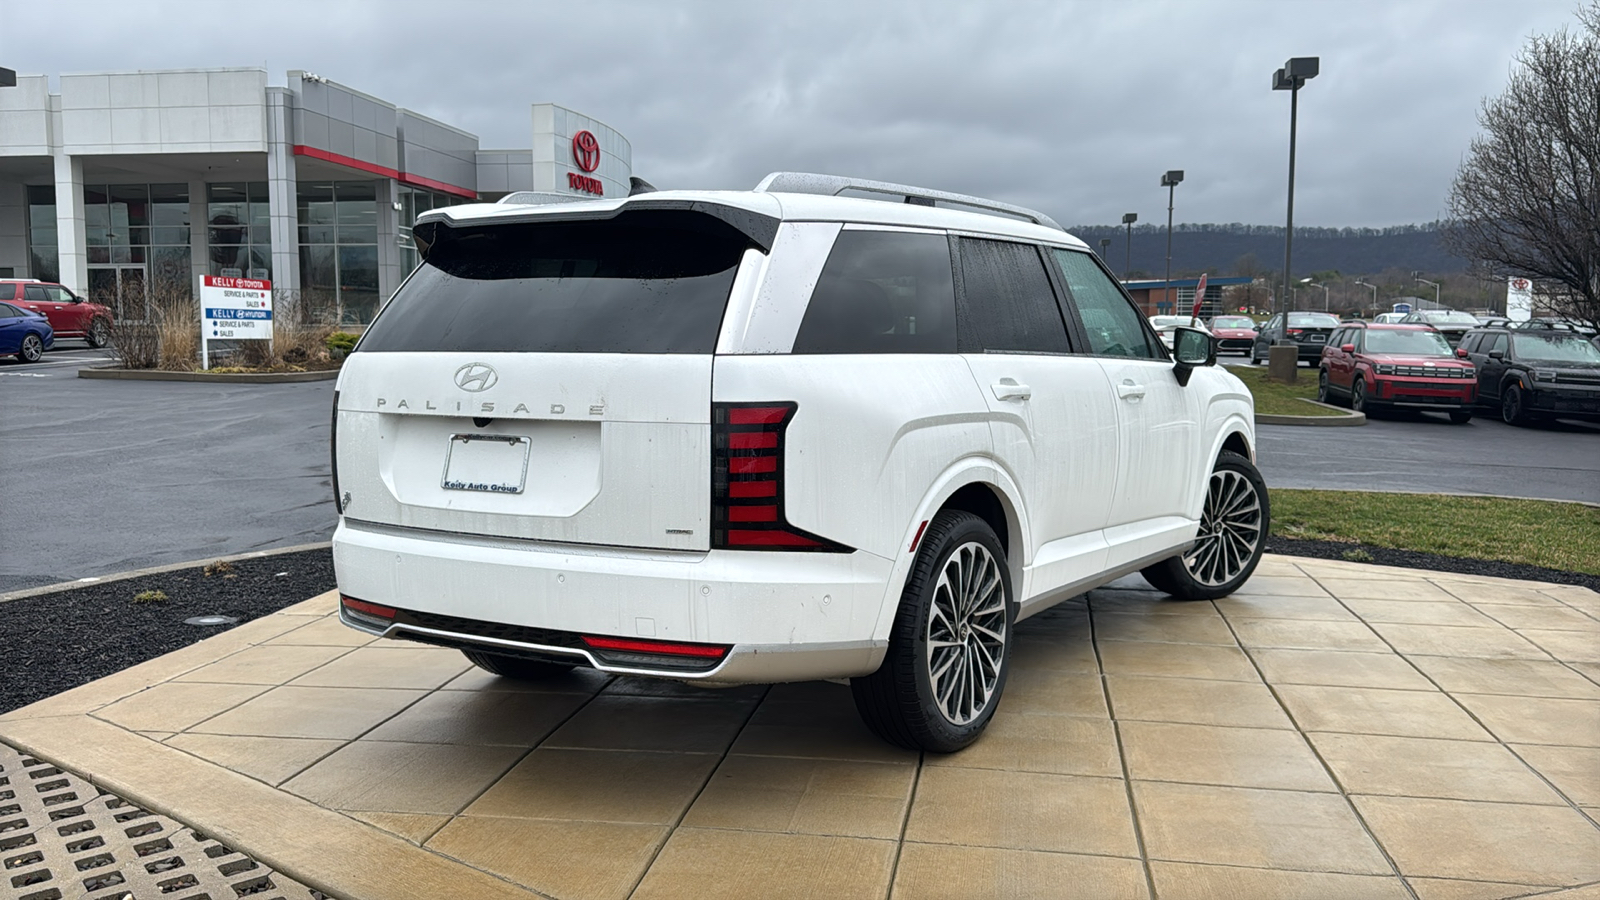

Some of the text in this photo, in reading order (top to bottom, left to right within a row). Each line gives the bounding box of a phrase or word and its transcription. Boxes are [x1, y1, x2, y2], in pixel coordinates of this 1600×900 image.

[568, 172, 604, 196] TOYOTA
[212, 277, 264, 289] KELLY TOYOTA
[224, 290, 242, 298] SERVICE
[246, 291, 259, 299] PARTS
[212, 309, 267, 319] KELLY HYUNDAI
[241, 321, 255, 329] PARTS
[377, 398, 605, 416] PALISADE
[467, 482, 488, 491] Auto
[490, 484, 518, 493] Group
